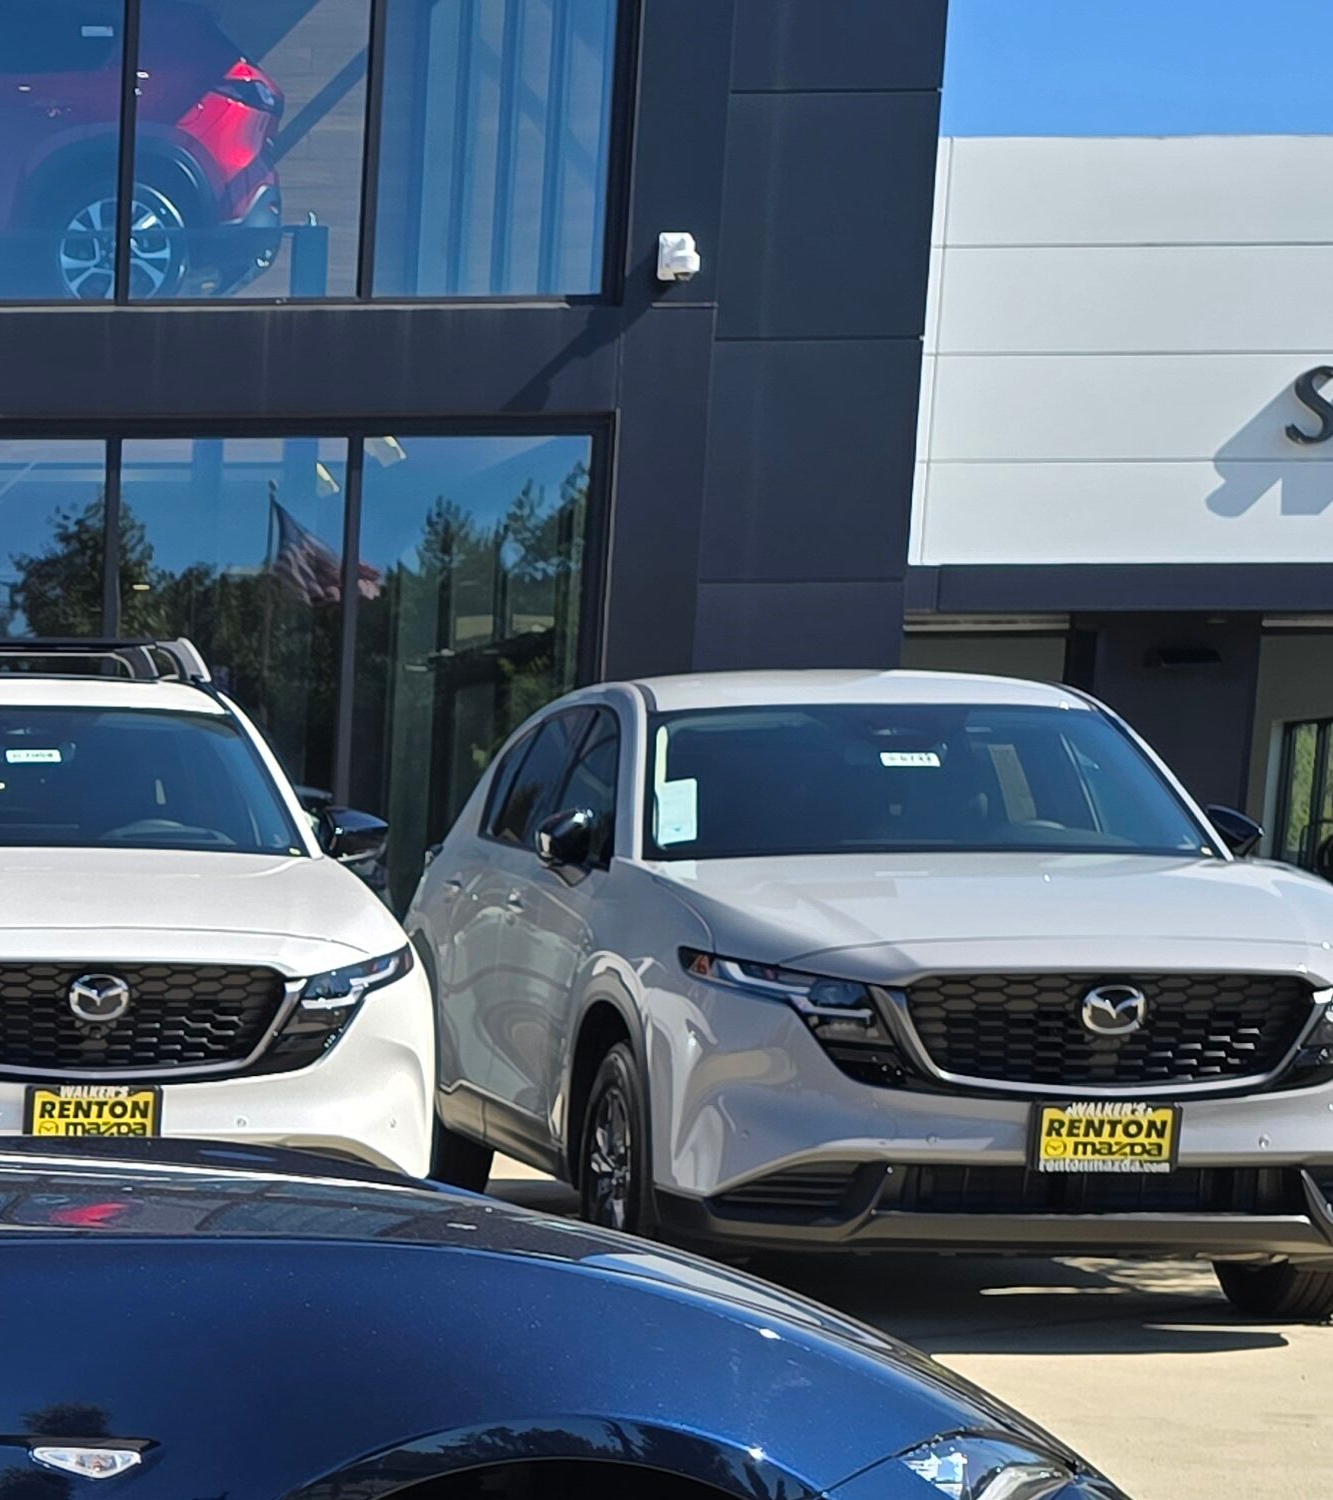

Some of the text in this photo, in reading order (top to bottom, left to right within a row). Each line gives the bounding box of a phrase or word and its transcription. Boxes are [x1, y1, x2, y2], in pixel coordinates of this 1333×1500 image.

[60, 1085, 130, 1099] WALKER'S
[39, 1100, 150, 1119] RENTON
[1070, 1102, 1147, 1117] WALKER'S
[64, 1121, 147, 1135] mazda
[1045, 1118, 1168, 1139] RENTON
[1072, 1140, 1163, 1157] mazda
